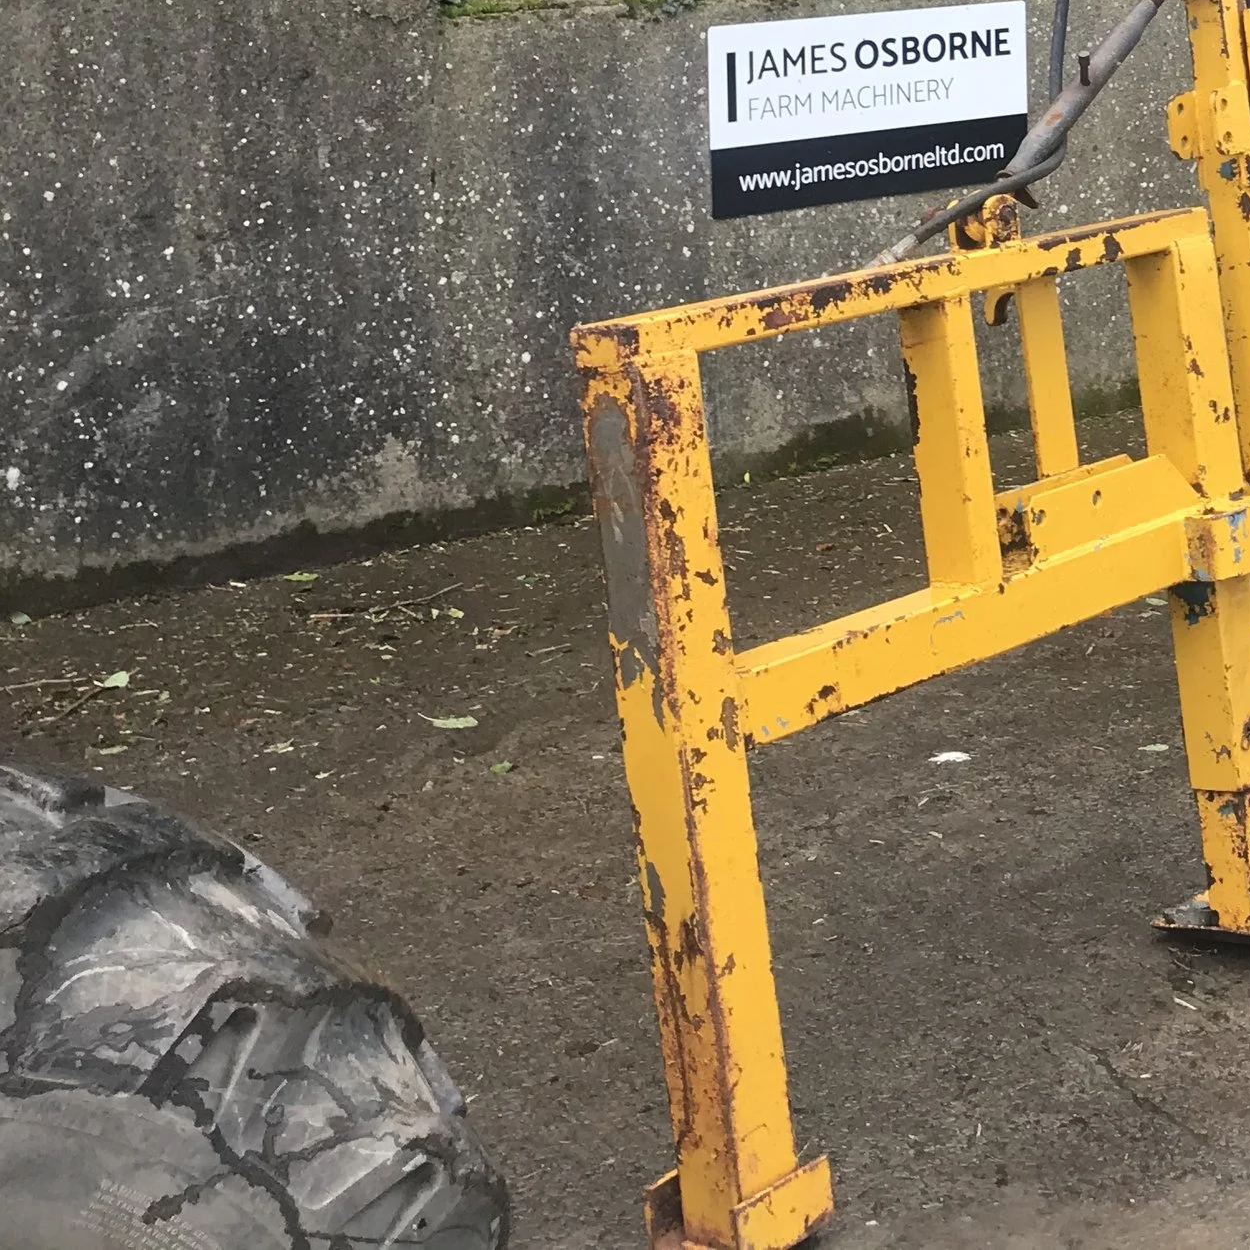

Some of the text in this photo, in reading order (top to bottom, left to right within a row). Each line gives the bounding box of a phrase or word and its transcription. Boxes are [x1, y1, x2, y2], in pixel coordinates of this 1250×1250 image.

[747, 27, 1012, 85] JAMES OSBORNE
[748, 77, 954, 121] FARM MACHINERY
[738, 142, 1005, 192] www.jamesosborneltd.com
